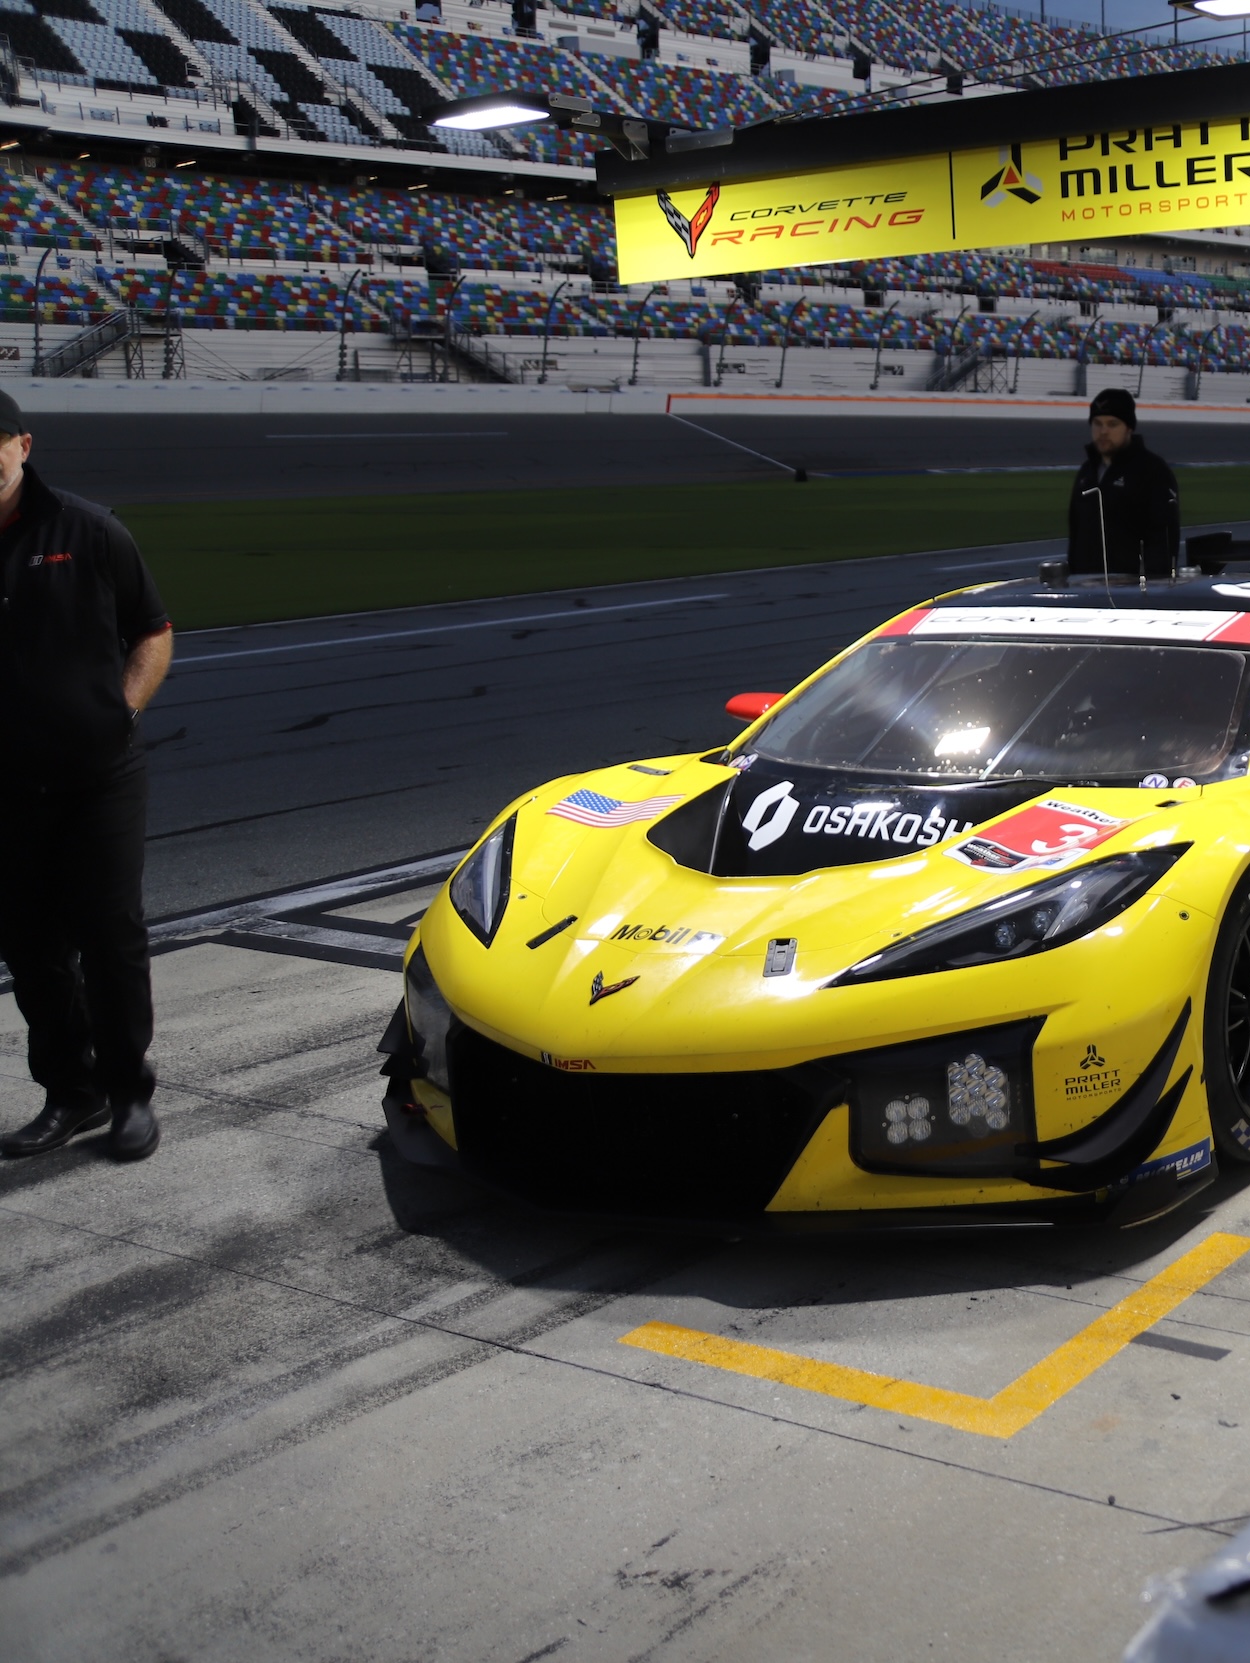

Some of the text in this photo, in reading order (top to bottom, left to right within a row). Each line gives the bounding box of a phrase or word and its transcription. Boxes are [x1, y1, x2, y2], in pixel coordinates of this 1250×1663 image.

[730, 191, 908, 222] CORVETTE
[711, 209, 925, 246] RACING
[928, 615, 1213, 628] CORVETTE
[803, 803, 974, 846] OSHKOSH
[1031, 823, 1098, 854] 3
[610, 924, 692, 945] Mobil
[554, 1058, 596, 1070] IMSA
[1065, 1068, 1121, 1086] PRATT
[1065, 1079, 1121, 1095] MILLER
[1066, 1087, 1122, 1101] MOTORSPORTS
